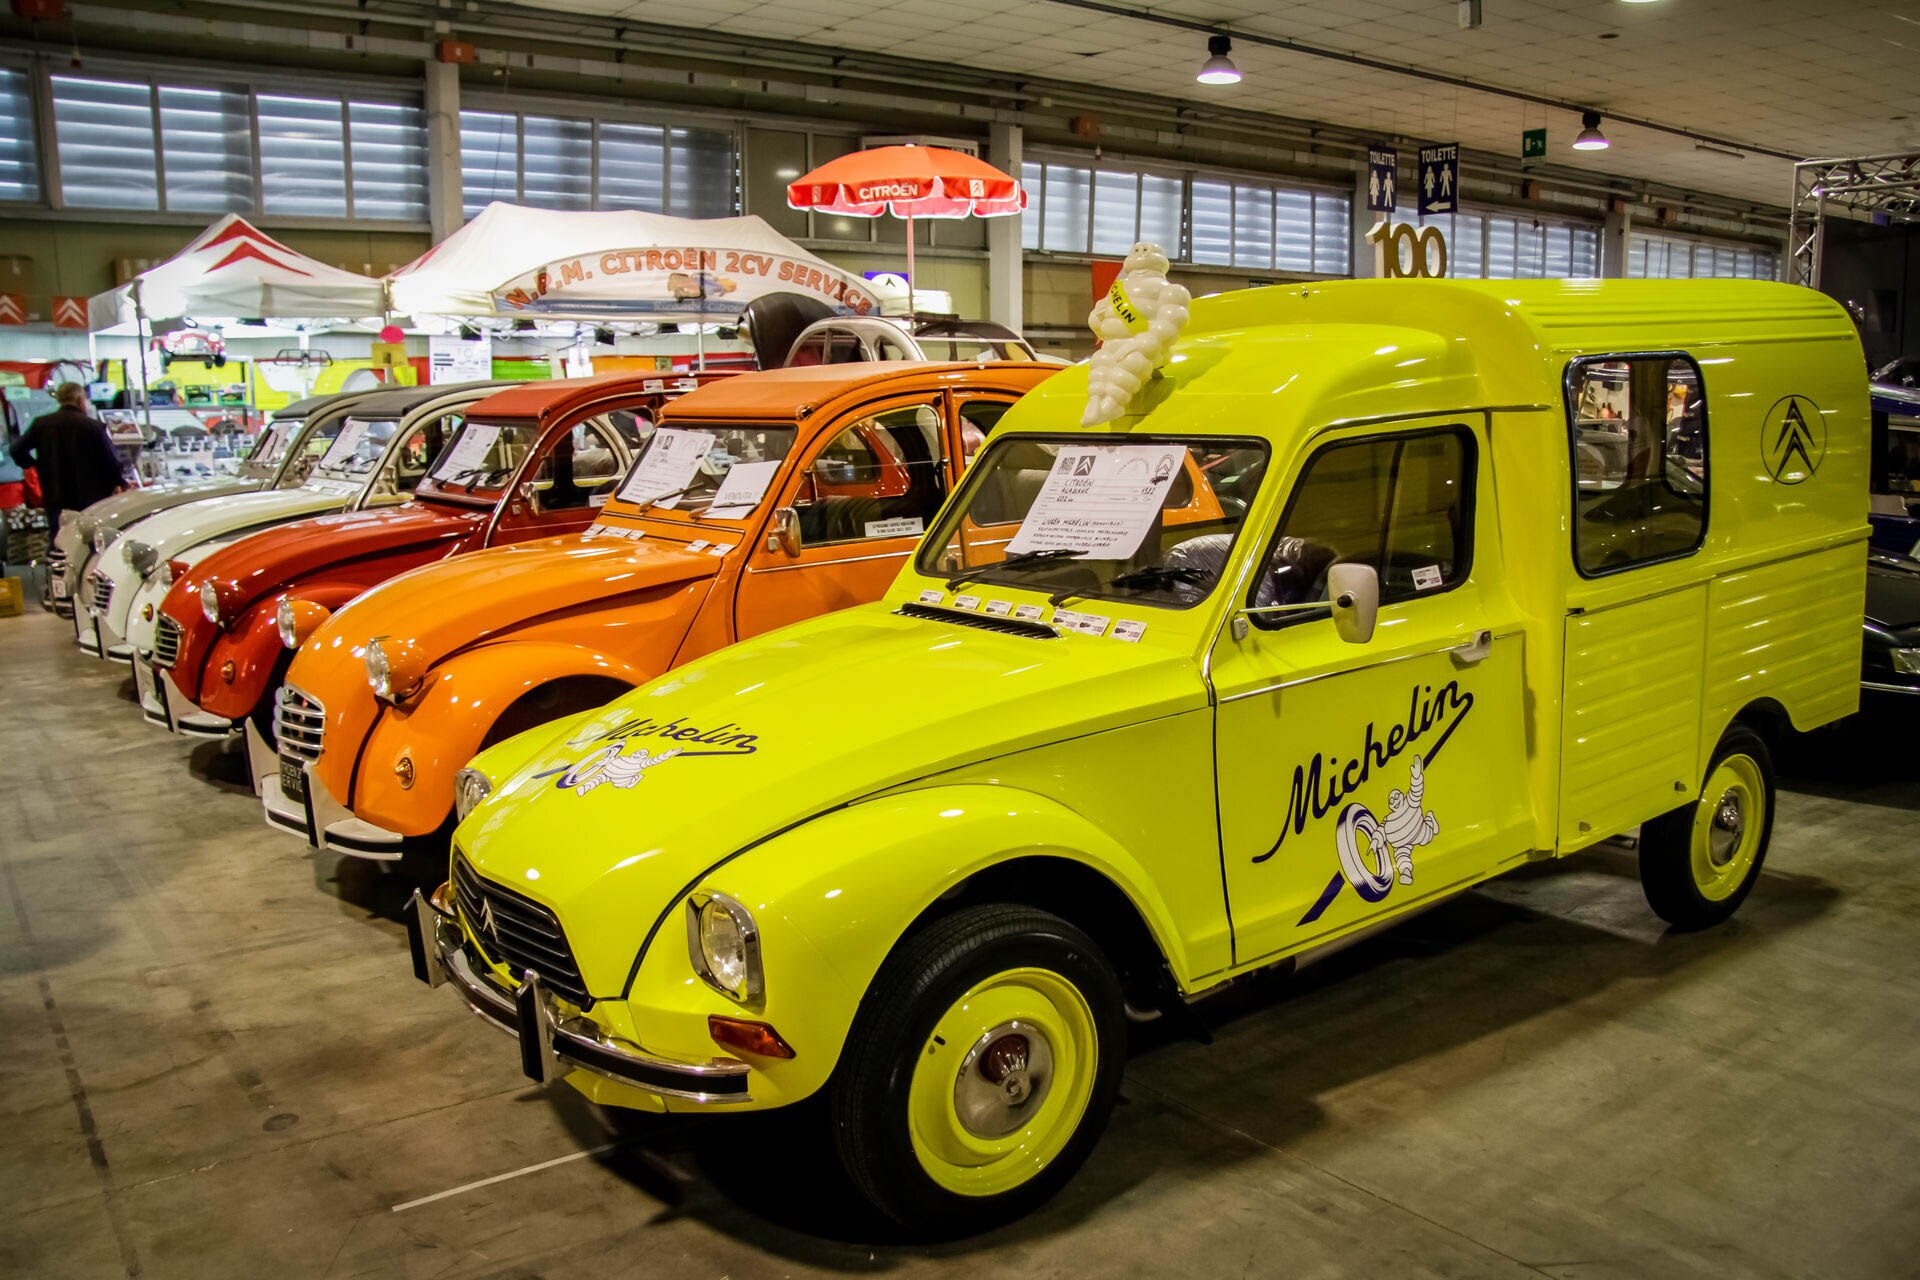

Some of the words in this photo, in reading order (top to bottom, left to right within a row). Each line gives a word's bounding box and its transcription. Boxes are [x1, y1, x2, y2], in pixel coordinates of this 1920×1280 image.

[1369, 150, 1396, 166] TOILETTE
[1421, 147, 1456, 163] TOILETTE
[1365, 222, 1447, 278] 100
[505, 260, 593, 310] N.P.M.
[601, 247, 717, 275] CITROËN
[725, 252, 774, 277] 2CV
[777, 261, 873, 316] SERVICE
[1110, 283, 1136, 324] CHELIN
[567, 717, 758, 756] Michelin
[1252, 680, 1474, 863] Michelin
